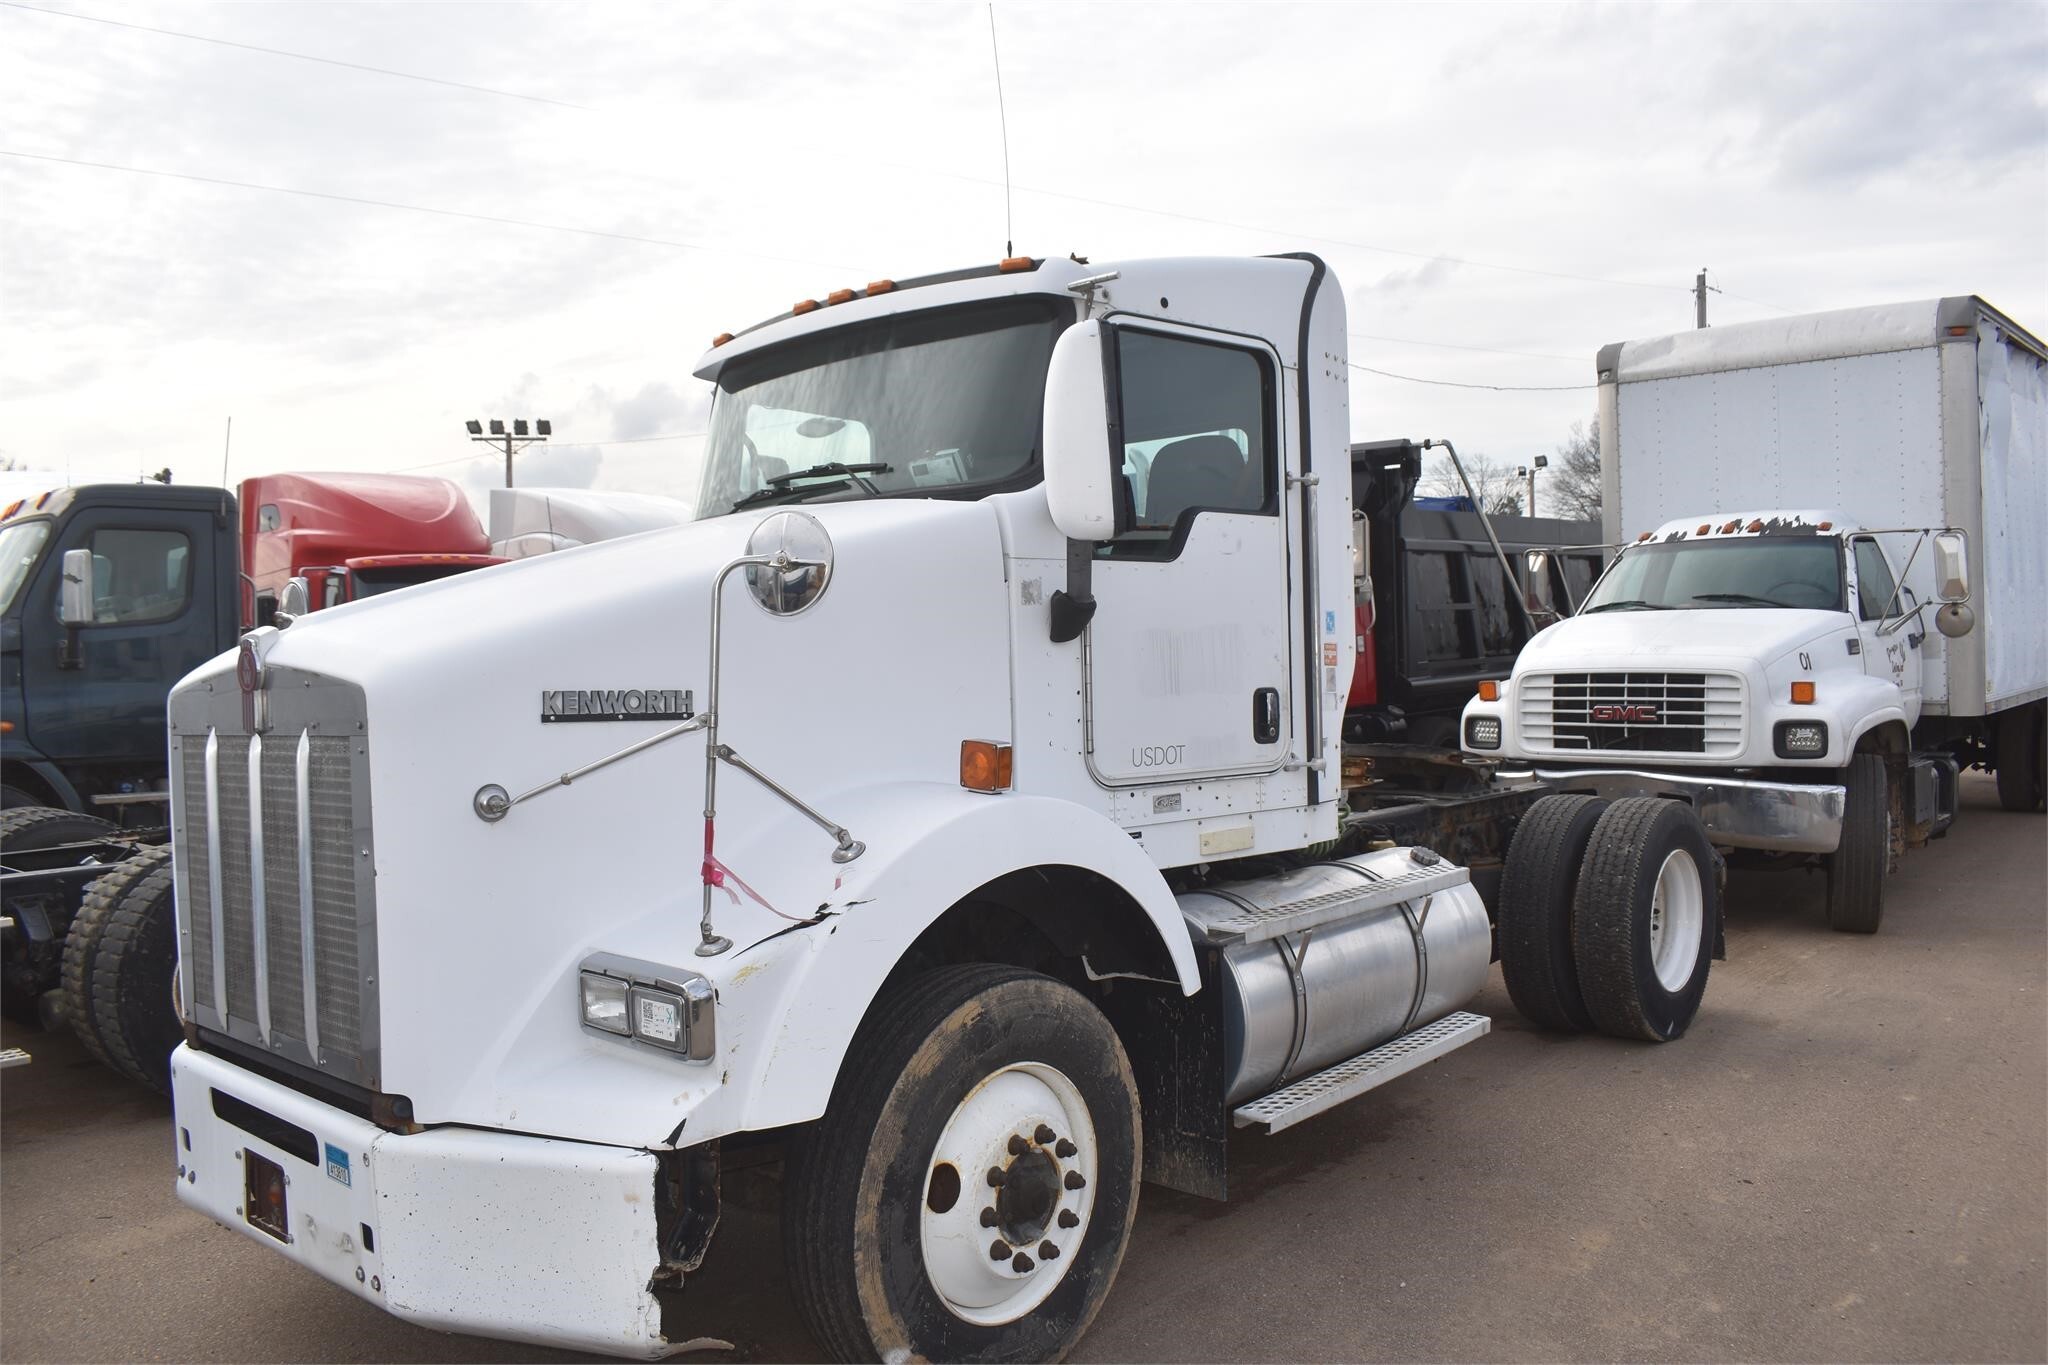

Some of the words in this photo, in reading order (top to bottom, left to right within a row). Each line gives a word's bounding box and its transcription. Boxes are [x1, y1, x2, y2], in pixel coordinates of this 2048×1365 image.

[542, 689, 694, 715] KENWORTH
[1593, 705, 1658, 721] GMC
[1132, 745, 1186, 768] USDOT
